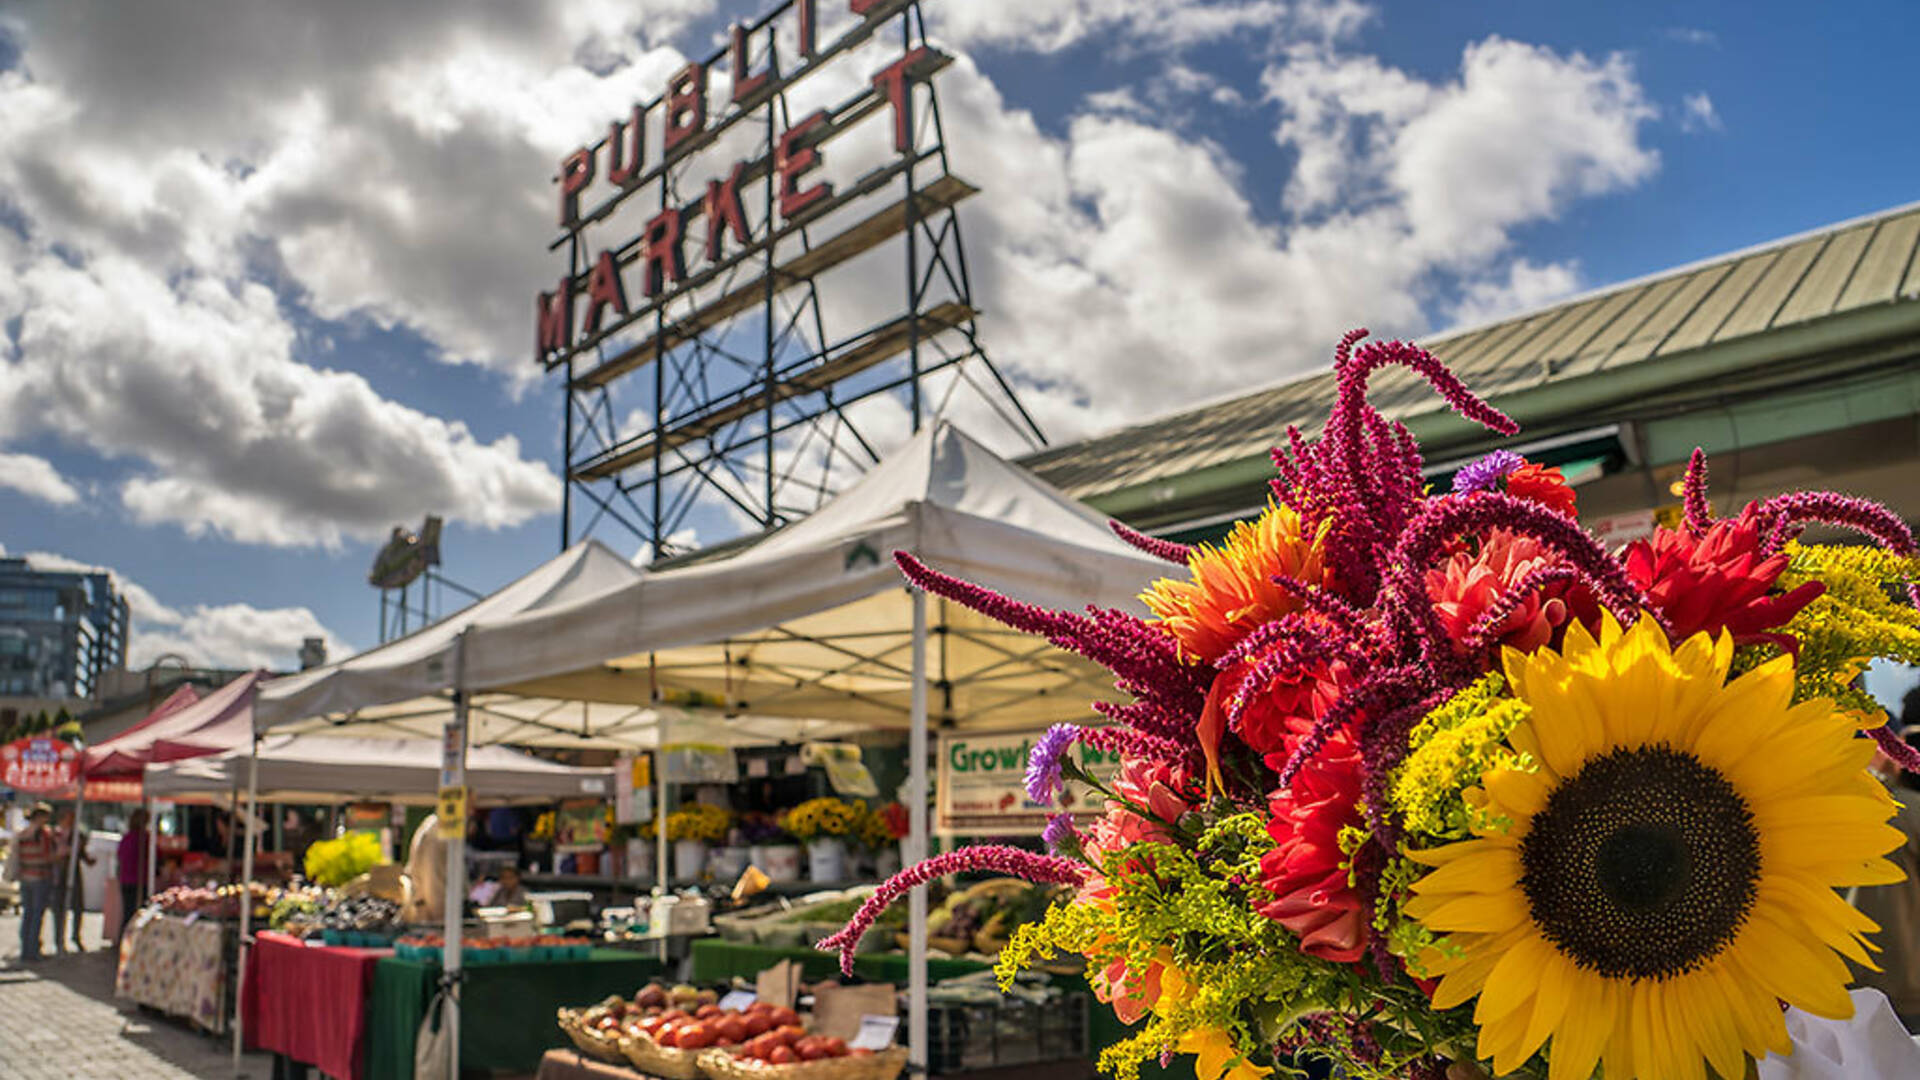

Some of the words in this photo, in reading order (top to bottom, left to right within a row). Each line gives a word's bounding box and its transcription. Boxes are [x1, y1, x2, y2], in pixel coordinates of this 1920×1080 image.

[537, 46, 935, 362] MARKET
[560, 0, 893, 227] PUBLI
[951, 740, 1030, 771] Growi
